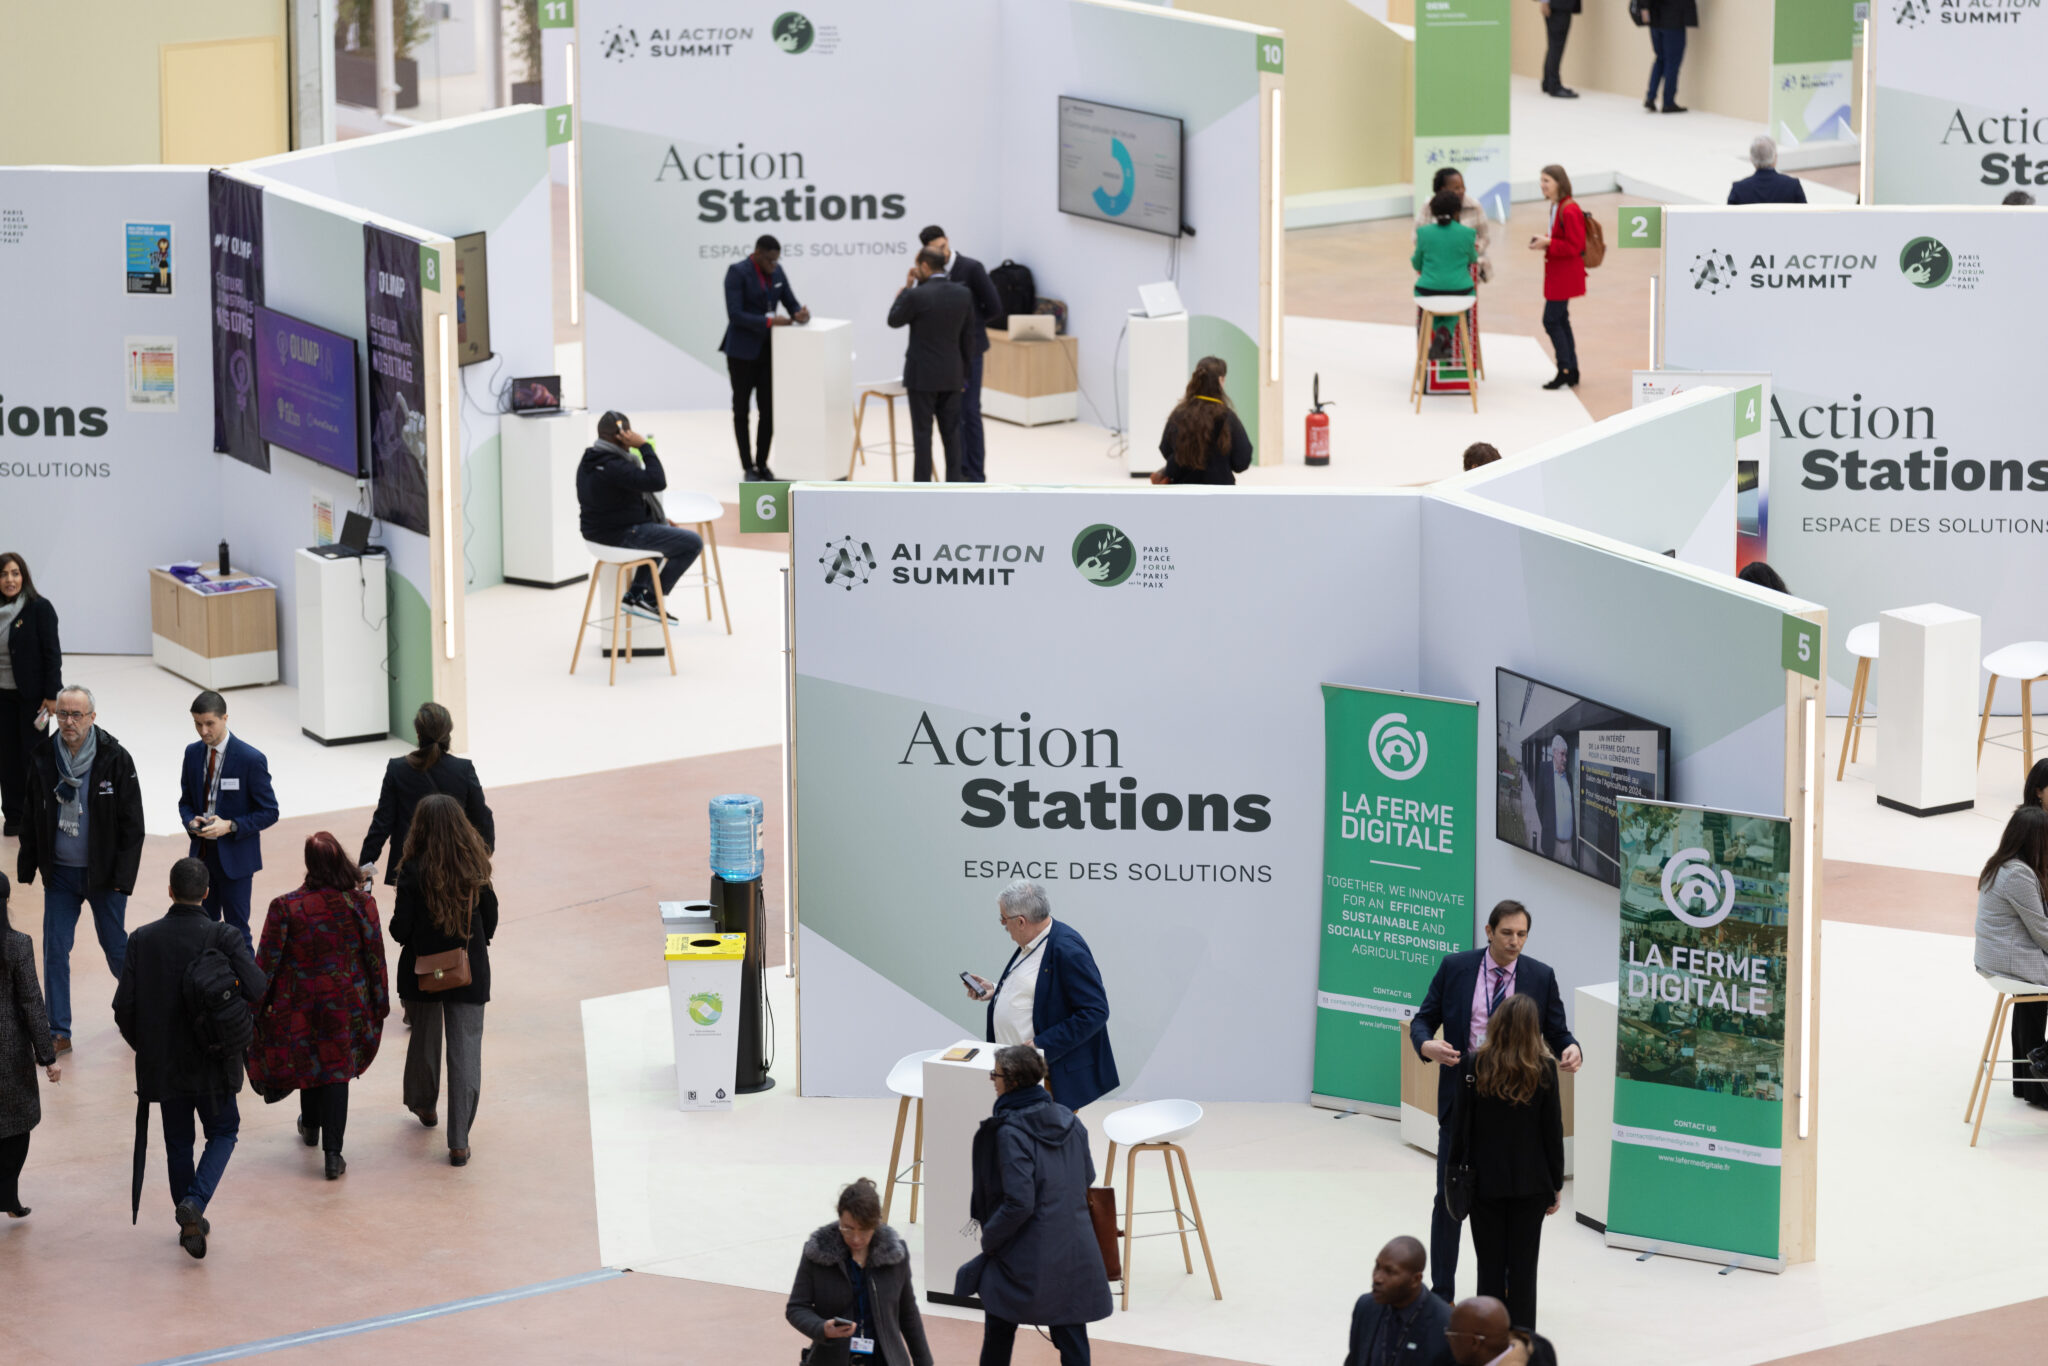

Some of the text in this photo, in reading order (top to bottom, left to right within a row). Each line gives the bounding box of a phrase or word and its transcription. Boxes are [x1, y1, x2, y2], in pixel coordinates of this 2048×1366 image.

[544, 1, 567, 20] 11
[1940, 11, 2021, 24] SUMMIT
[650, 27, 754, 41] AI ACTION
[650, 44, 734, 57] SUMMIT
[1262, 43, 1282, 64] 10
[556, 114, 567, 135] 7
[654, 142, 806, 182] Action
[697, 185, 906, 223] Stations
[1631, 216, 1648, 238] 2
[700, 245, 754, 259] ESPAC
[810, 242, 908, 257] SOLUTIONS
[426, 257, 436, 281] 8
[1750, 254, 1877, 270] AI ACTION
[1750, 273, 1852, 289] SUMMIT
[1745, 398, 1756, 423] 4
[1770, 393, 1937, 439] Action
[0, 461, 111, 478] SOLUTIONS
[1801, 446, 2048, 491] Stations
[756, 494, 777, 520] 6
[1802, 517, 2048, 534] ESPACE DES SOLUTION
[892, 543, 1045, 563] AI ACTION
[892, 566, 1015, 586] SUMMIT
[1798, 632, 1811, 662] 5
[898, 710, 1124, 768] Action
[1617, 746, 1641, 755] DIGITALE
[960, 776, 1272, 833] Stations
[1342, 791, 1454, 827] LA FERME
[1341, 815, 1454, 854] DIGITALE
[963, 860, 1272, 882] ESPACE DES SOLUTIONS
[1326, 874, 1465, 906] TOGETHER, WE INNOVATE
[1343, 893, 1446, 919] FOR AN EFFICIENT
[1342, 910, 1446, 936] SUSTAINABLE AND
[1327, 923, 1460, 954] SOCIALLY RESPONSIBLE
[1351, 943, 1429, 966] AGRICULTURE
[1629, 940, 1767, 985] LA FERME
[1372, 986, 1412, 999] CONTACT US
[1628, 969, 1767, 1017] DIGITALE
[1359, 1020, 1400, 1032] www.lafermed
[1673, 1119, 1717, 1133] CONTACT US
[1658, 1154, 1730, 1171] www.lafermedigitale.fr
